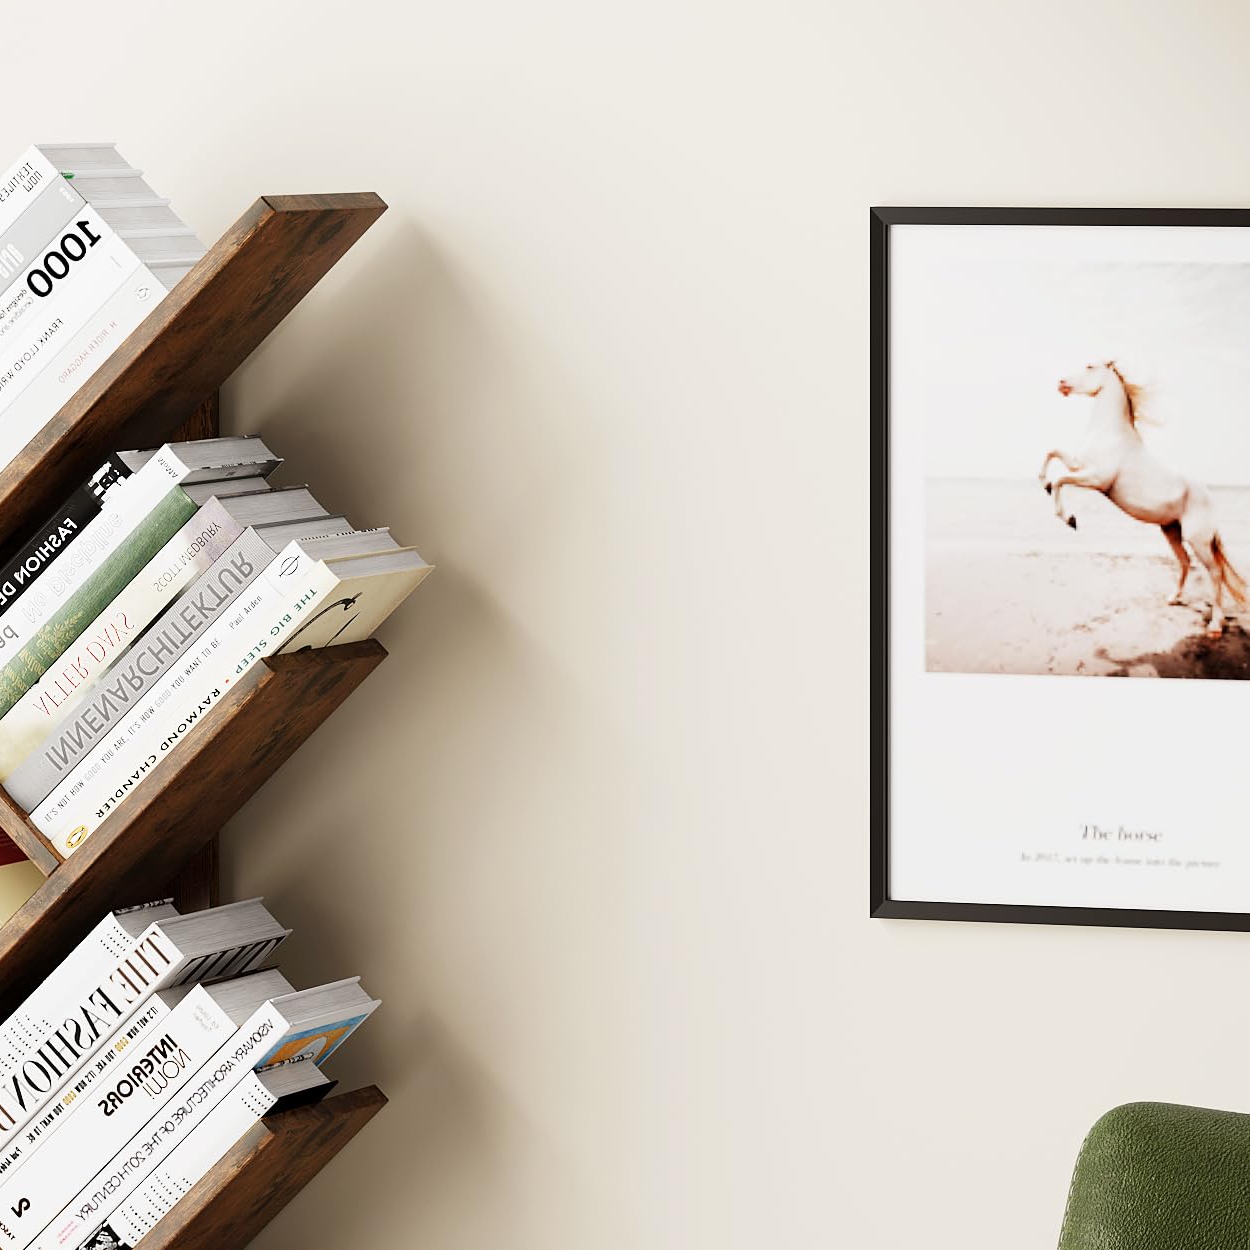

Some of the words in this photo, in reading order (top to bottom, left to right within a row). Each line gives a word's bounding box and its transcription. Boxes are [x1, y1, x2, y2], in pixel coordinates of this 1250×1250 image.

[228, 613, 245, 630] Paul
[242, 595, 263, 614] Arden
[292, 588, 317, 612] THE
[268, 613, 293, 637] BIG
[233, 639, 268, 675] SLEEP
[56, 794, 71, 810] NOT
[69, 780, 85, 796] HOW
[100, 748, 115, 764] YOU
[126, 720, 142, 736] IT'S
[139, 705, 156, 723] HOW
[170, 674, 186, 690] YOU
[183, 656, 203, 676] WANT
[200, 647, 212, 658] TO
[159, 687, 221, 752] RAYMOND
[94, 753, 157, 820] CHANDLER
[1080, 824, 1112, 840] The
[1117, 825, 1163, 840] horse
